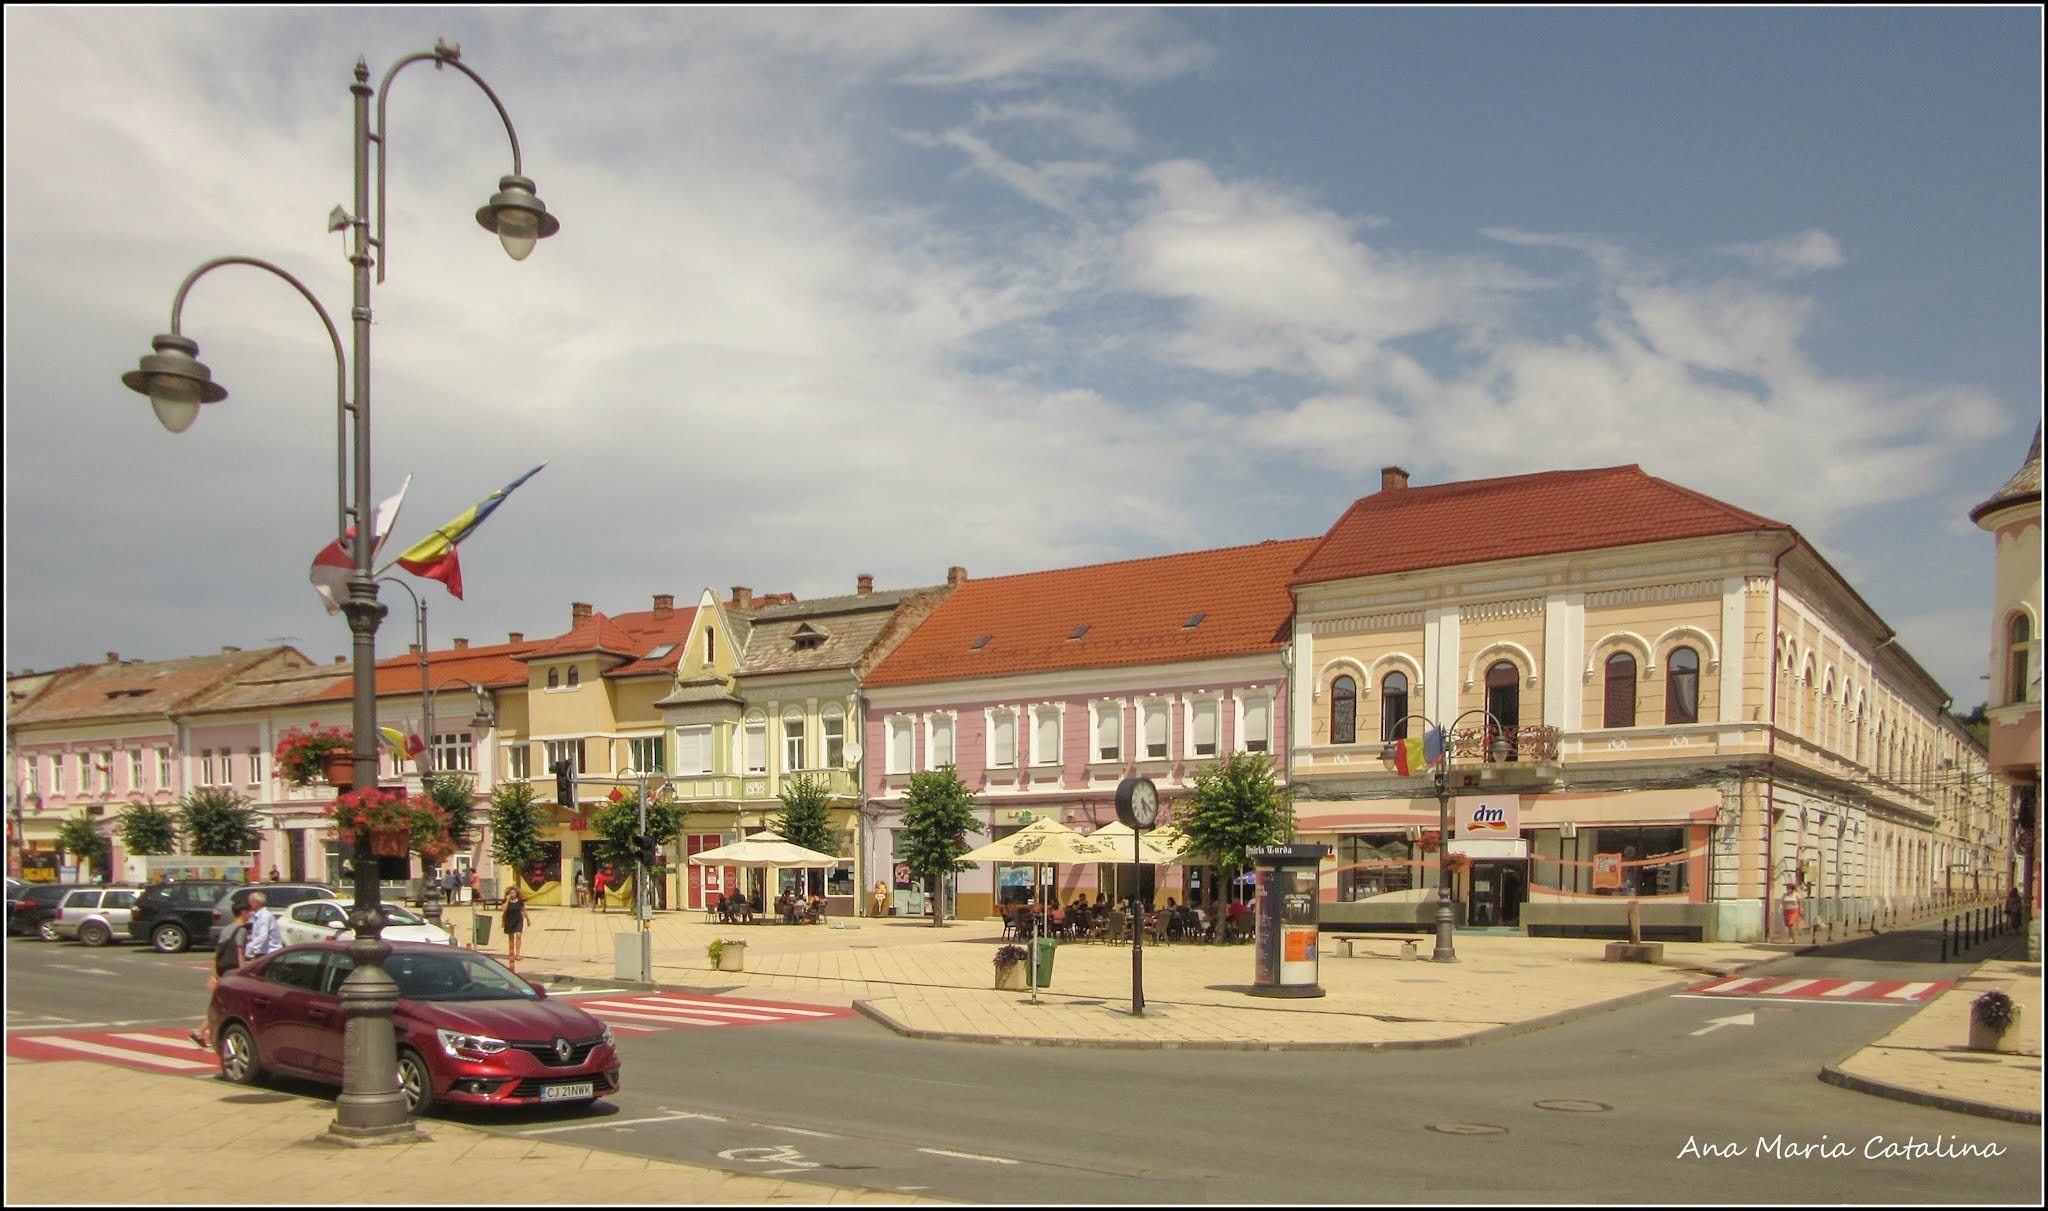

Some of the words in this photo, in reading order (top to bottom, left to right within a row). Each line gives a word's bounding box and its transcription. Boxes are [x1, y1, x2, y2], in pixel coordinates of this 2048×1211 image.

[1473, 804, 1503, 822] dm
[1266, 845, 1292, 854] Turda
[547, 1087, 560, 1098] CJ
[562, 1084, 592, 1097] 21NWK
